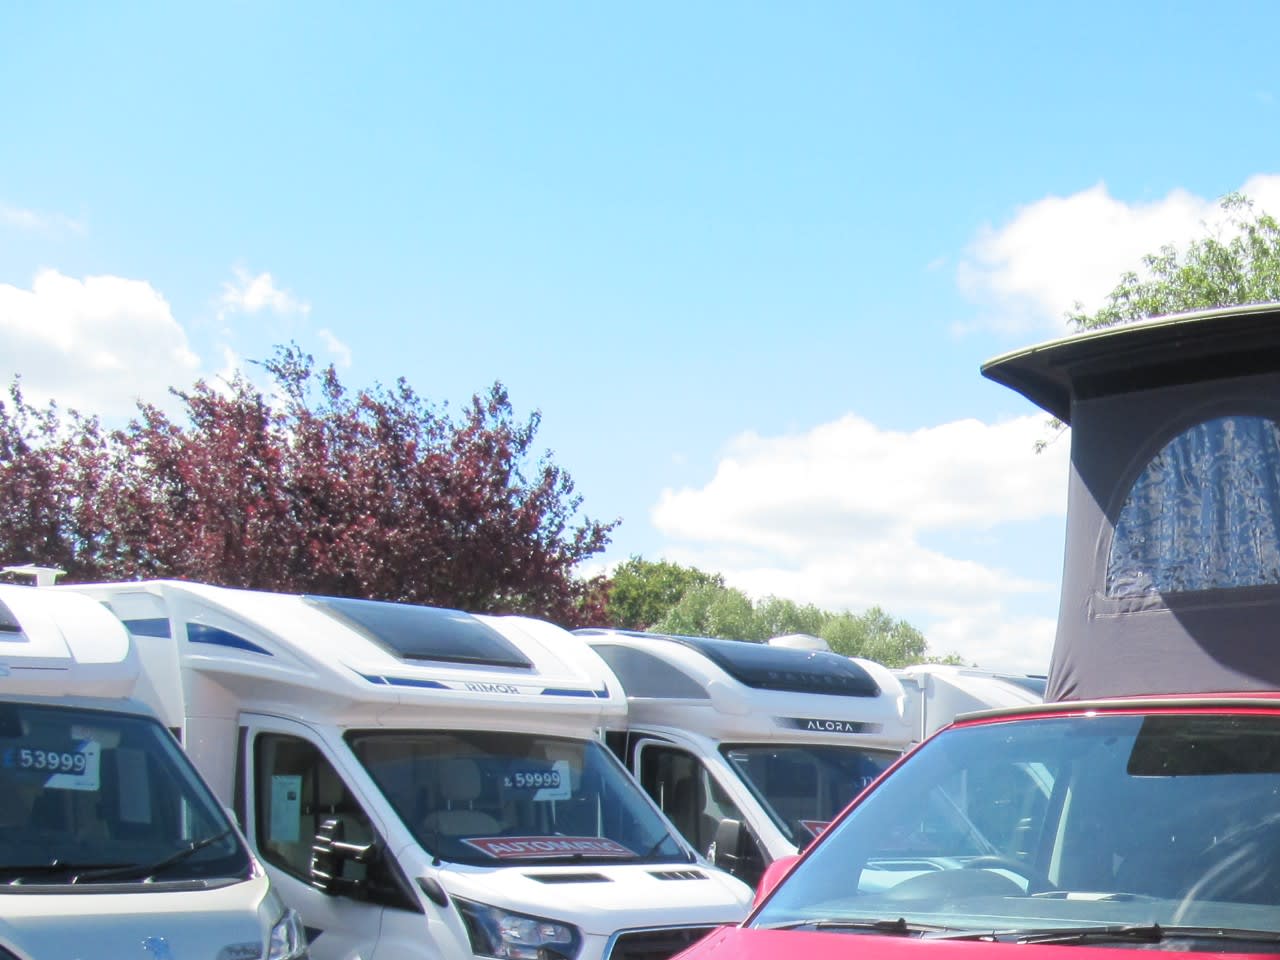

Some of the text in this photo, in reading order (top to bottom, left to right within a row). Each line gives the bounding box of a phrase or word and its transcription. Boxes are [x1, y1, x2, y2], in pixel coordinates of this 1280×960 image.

[463, 681, 520, 695] RIMOR
[807, 720, 853, 732] ALORA
[487, 841, 623, 853] AUTOMATIC
